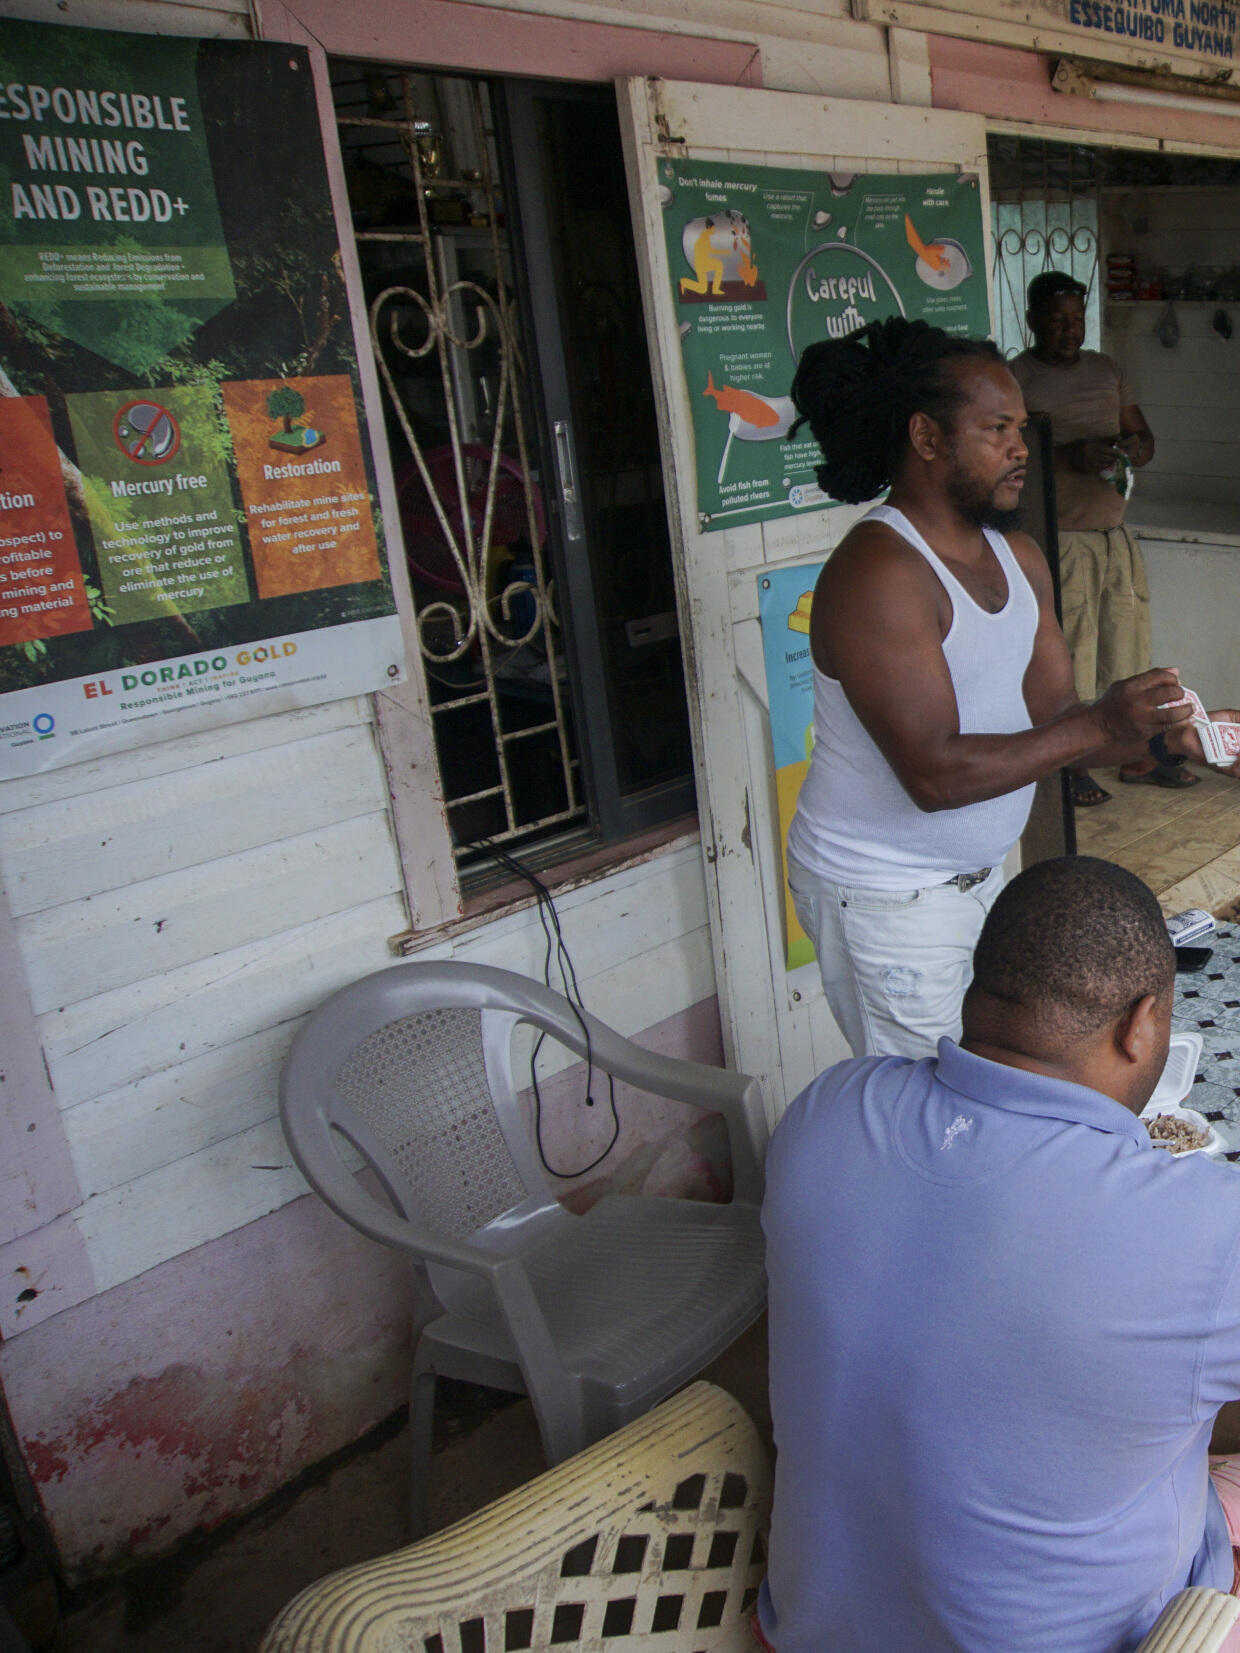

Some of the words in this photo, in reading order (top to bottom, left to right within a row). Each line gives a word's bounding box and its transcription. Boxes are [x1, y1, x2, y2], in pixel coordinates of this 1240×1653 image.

[1190, 0, 1236, 33] NORTH
[1069, 0, 1164, 43] ESSEQUIBO
[1173, 21, 1232, 59] GUYANA
[22, 134, 149, 176] MINING
[678, 177, 698, 187] Don't
[699, 178, 723, 188] inhale
[724, 182, 758, 192] mercury
[11, 182, 81, 220] AND
[86, 186, 190, 222] REDD+
[705, 192, 727, 201] fumes
[806, 267, 876, 305] Careful
[733, 304, 747, 312] gold
[698, 315, 730, 323] dangerous
[721, 324, 745, 332] working
[826, 306, 866, 338] with
[720, 353, 748, 362] Pregnant
[730, 373, 750, 383] higher
[780, 444, 791, 452] Fish
[263, 458, 342, 480] Restoration
[784, 462, 806, 470] mercury
[111, 480, 174, 497] Mercury
[176, 473, 208, 490] free
[719, 483, 737, 494] Avoid
[738, 481, 751, 490] fish
[752, 479, 769, 488] from
[249, 499, 312, 515] Rehabilitate
[313, 494, 339, 505] mine
[340, 492, 365, 502] sites
[721, 493, 749, 507] polluted
[750, 490, 770, 501] rivers
[114, 521, 140, 532] Use
[142, 513, 193, 529] methods
[195, 510, 218, 521] and
[261, 518, 276, 528] for
[278, 514, 309, 526] forest
[310, 510, 330, 521] and
[331, 507, 359, 518] fresh
[48, 531, 63, 541] to
[102, 533, 171, 550] technology
[173, 531, 186, 540] to
[187, 524, 234, 538] improve
[262, 532, 292, 544] water
[294, 525, 337, 539] recovery
[340, 521, 361, 532] and
[109, 548, 162, 564] recovery
[164, 545, 177, 556] of
[179, 541, 205, 556] gold
[207, 539, 234, 549] from
[292, 543, 316, 554] after
[318, 541, 337, 550] use
[10, 566, 53, 581] before
[122, 568, 143, 577] ore
[145, 562, 170, 574] that
[172, 557, 212, 570] reduce
[214, 554, 227, 563] or
[2, 584, 47, 600] mining
[50, 579, 75, 592] and
[120, 577, 175, 593] eliminate
[177, 573, 197, 584] the
[199, 570, 220, 580] use
[222, 566, 234, 577] of
[156, 586, 205, 601] mercury
[21, 596, 74, 614] material
[83, 681, 113, 699] EL
[121, 655, 228, 691] DORADO
[236, 641, 297, 666] GOLD
[119, 690, 184, 710] Responsible
[186, 682, 220, 698] Mining
[222, 678, 238, 688] for
[239, 671, 276, 685] Guyana
